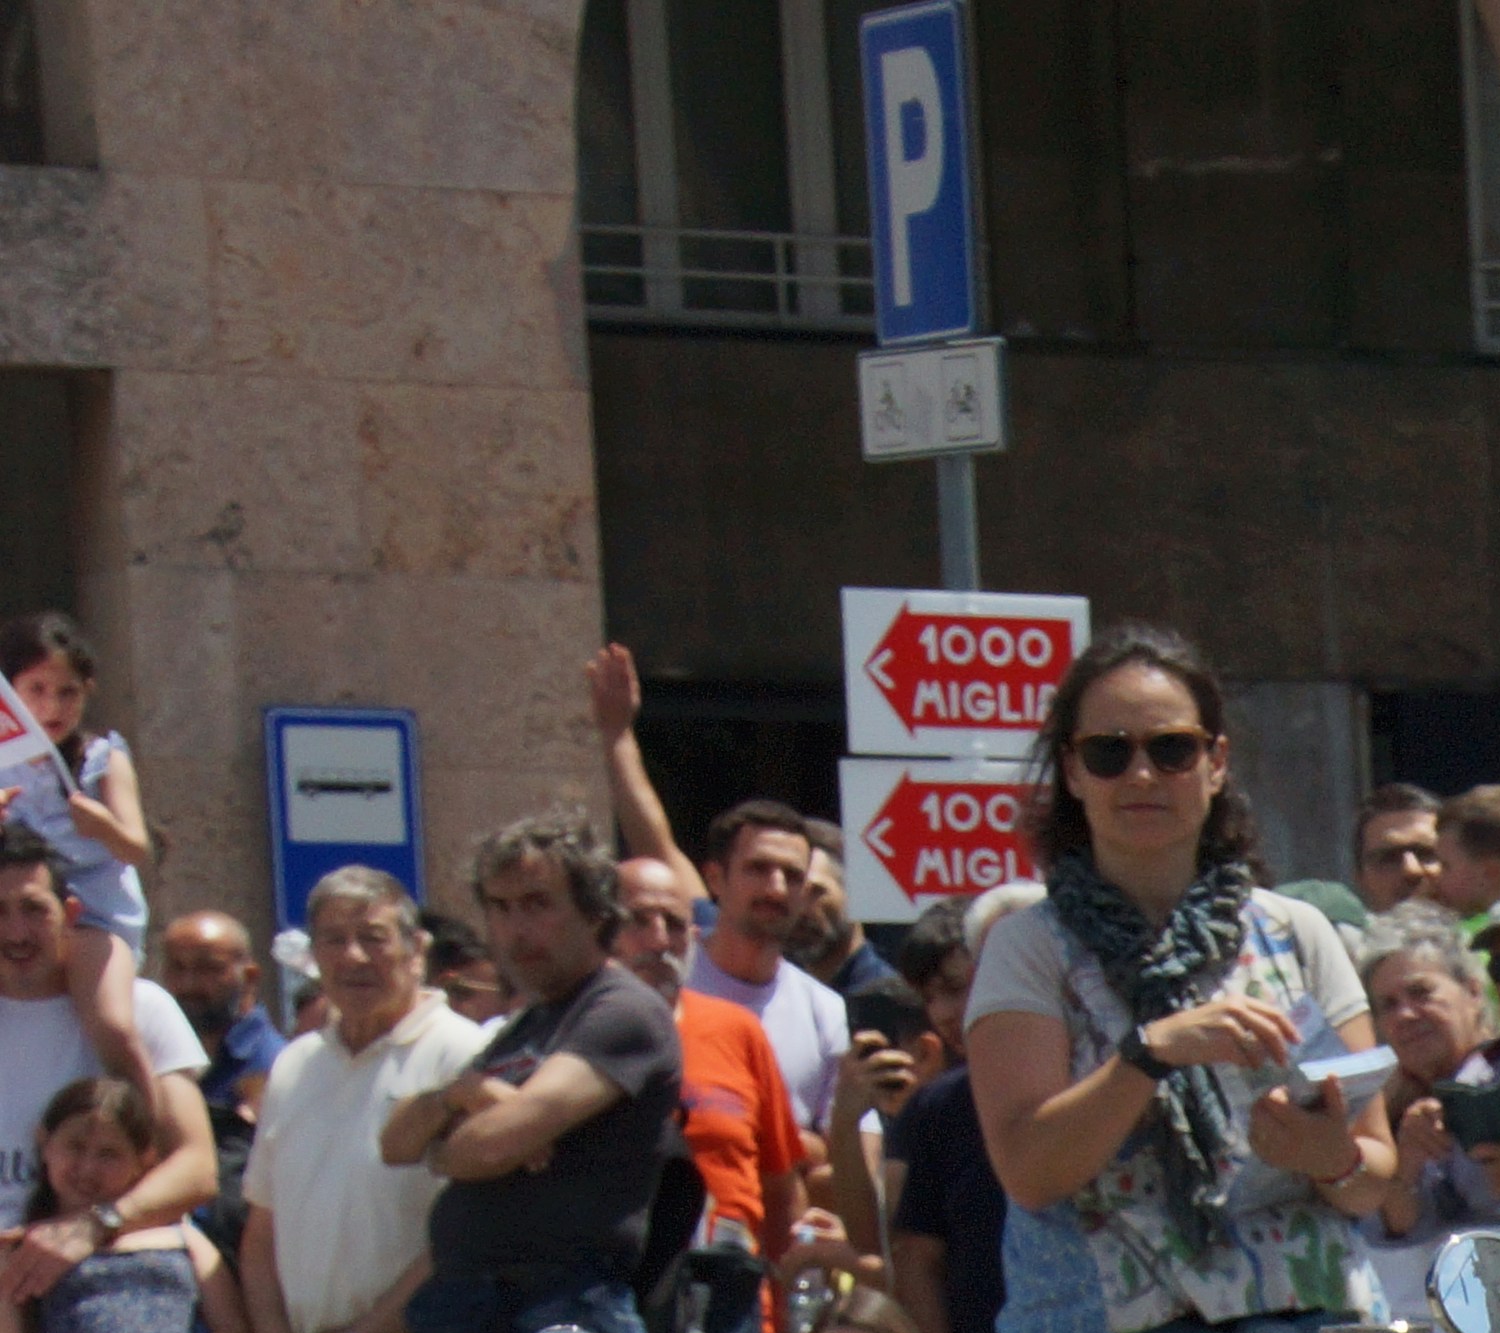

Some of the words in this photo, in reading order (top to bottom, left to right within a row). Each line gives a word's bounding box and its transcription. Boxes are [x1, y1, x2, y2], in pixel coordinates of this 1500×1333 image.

[881, 46, 943, 306] P
[918, 624, 1053, 668] 1000
[919, 791, 1019, 833] 100
[913, 847, 1044, 888] MIGL
